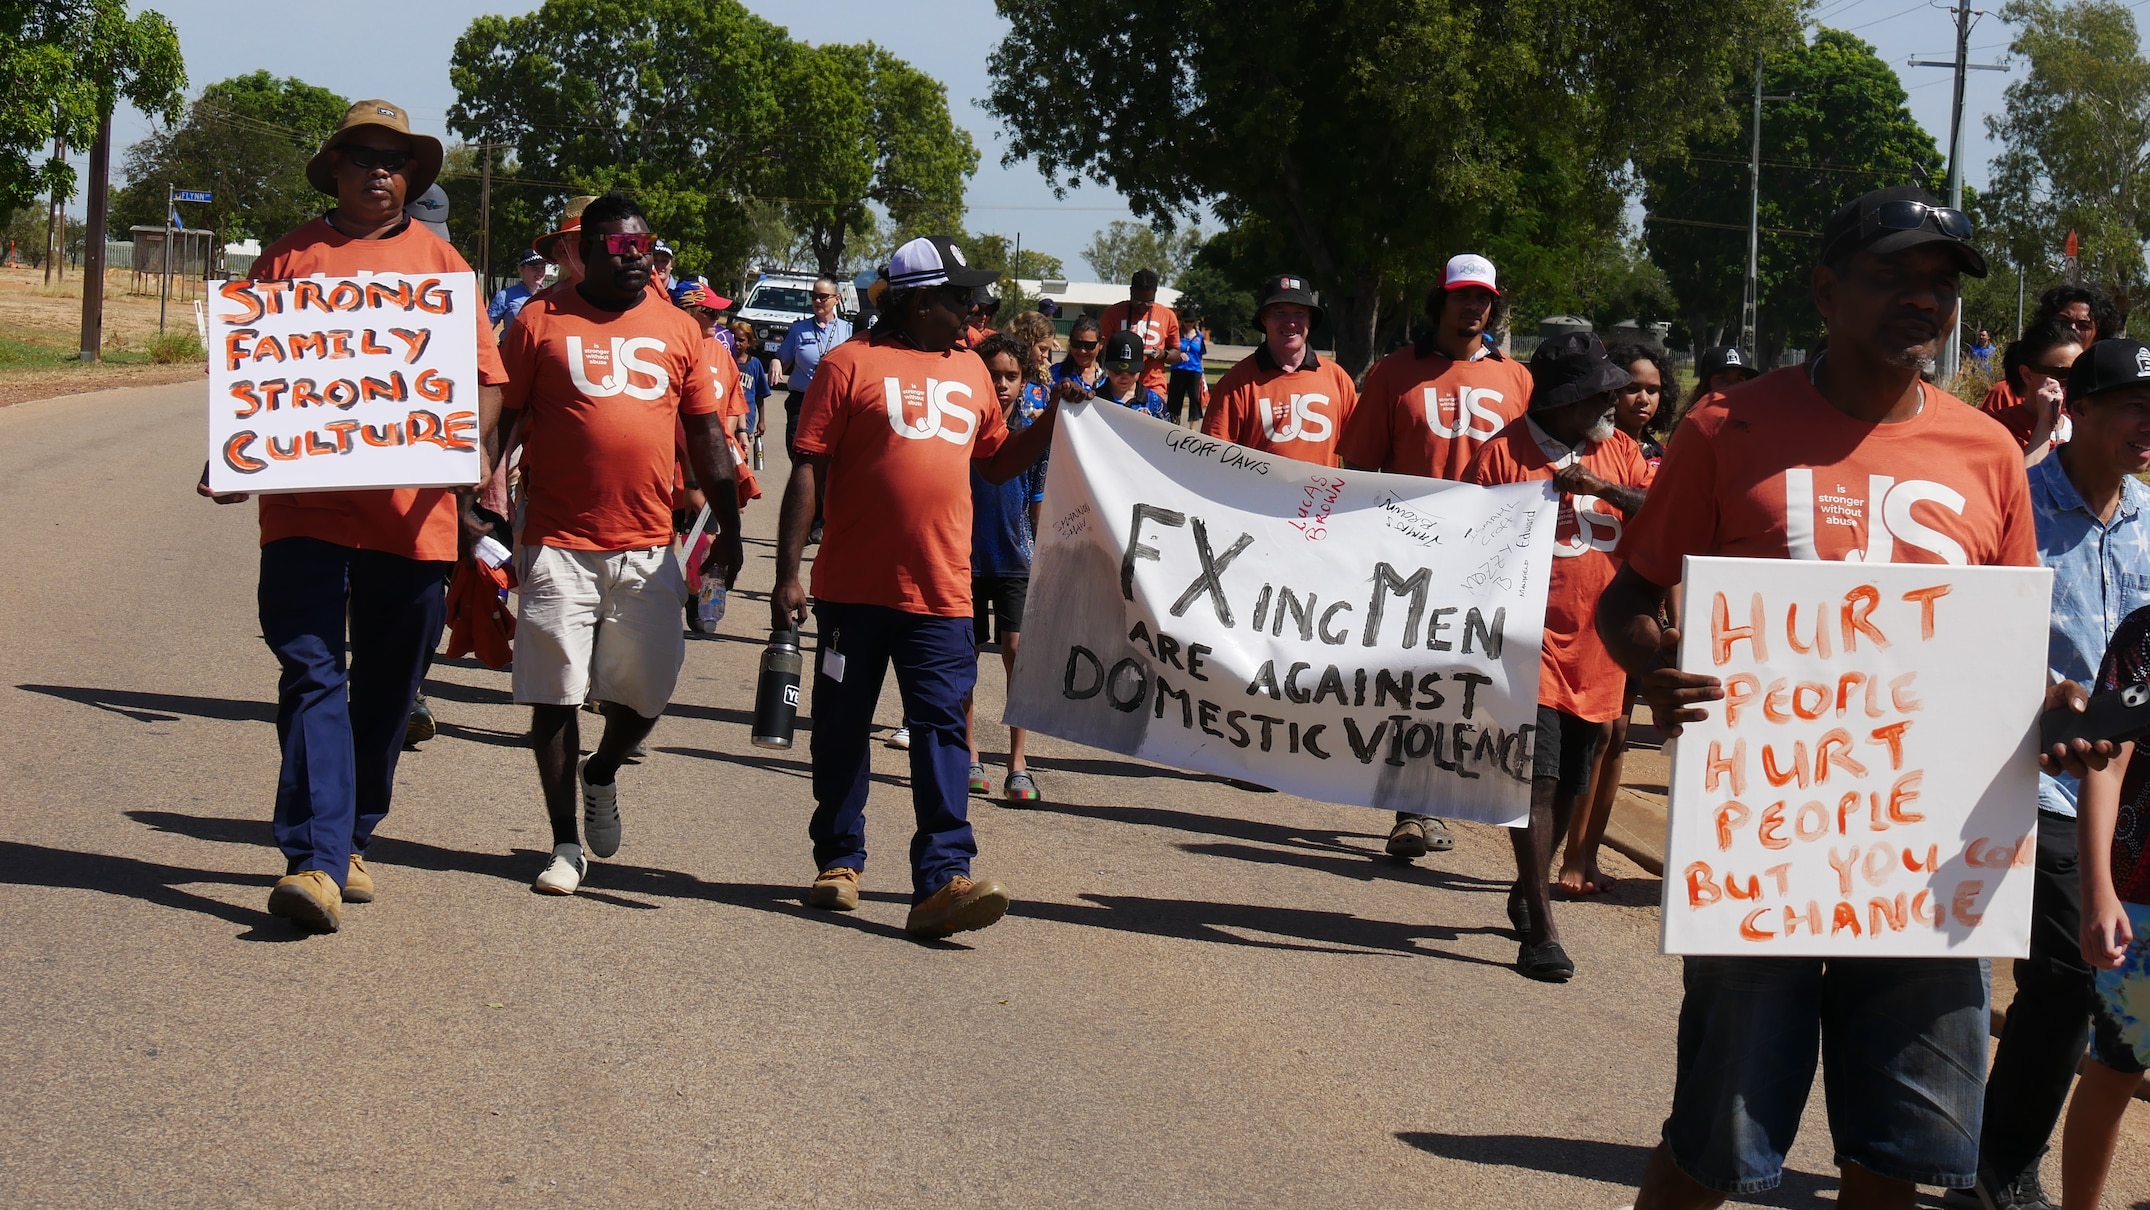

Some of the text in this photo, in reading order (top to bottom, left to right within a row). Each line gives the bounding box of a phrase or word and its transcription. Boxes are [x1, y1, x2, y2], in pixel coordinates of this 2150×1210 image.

[181, 191, 204, 200] FLYNN
[217, 279, 453, 326] STRONG
[225, 328, 431, 371] FAMILY
[566, 336, 669, 400] US
[229, 368, 454, 419] STRONG
[884, 377, 977, 445] US
[1259, 393, 1333, 442] US
[1424, 386, 1504, 442] US
[223, 410, 477, 474] CULTURE
[1166, 430, 1270, 475] GEOFF DAVIS
[1288, 475, 1328, 531] LUCAS
[1305, 477, 1345, 541] BROWN
[1786, 468, 1967, 565] US
[1818, 494, 1864, 507] stronger
[1821, 504, 1862, 518] without
[1837, 484, 1846, 493] is
[1516, 510, 1536, 548] Edward
[1826, 516, 1858, 527] abuse
[1362, 562, 1506, 660] MEN
[1711, 584, 1953, 667] HURT
[1128, 620, 1493, 719] ARE AGAINST
[1063, 645, 1537, 784] DOMESTIC VIOLENCE
[1725, 671, 1922, 729] PEOPLE
[1705, 720, 1913, 796] HURT
[1713, 768, 1926, 851] PEOPLE
[1683, 860, 1793, 911] BUT
[1828, 840, 1939, 898] YOU
[1738, 880, 1984, 942] CHANGE
